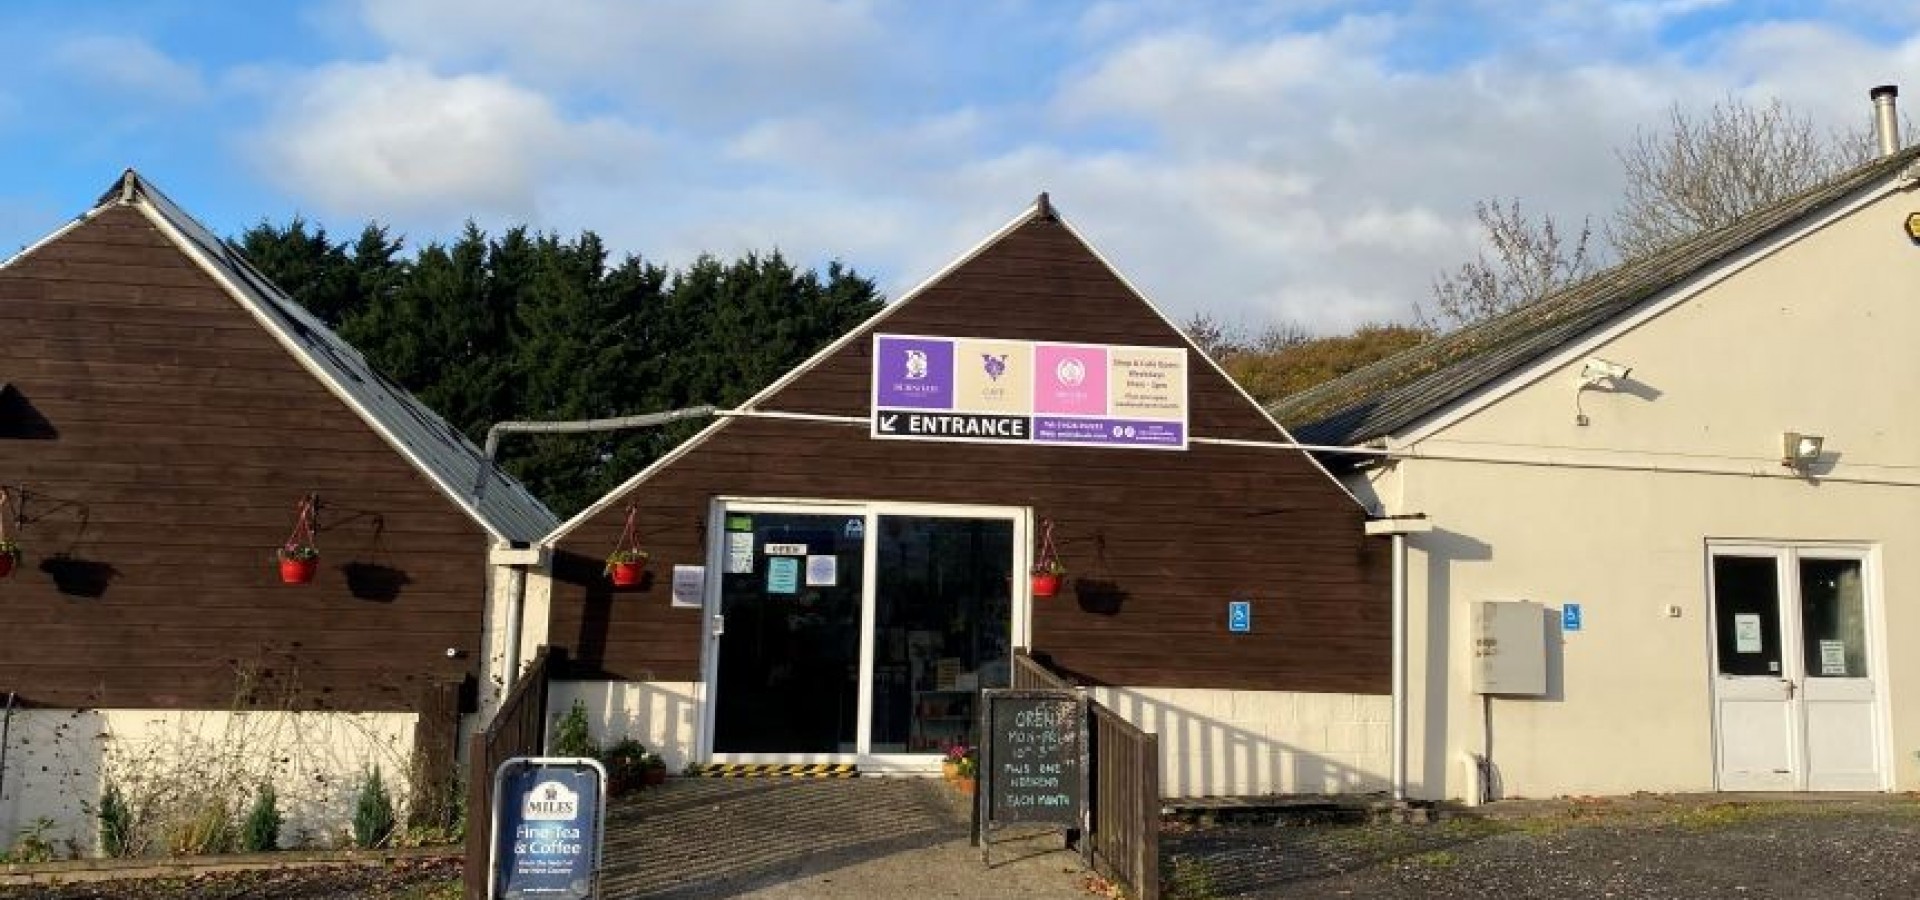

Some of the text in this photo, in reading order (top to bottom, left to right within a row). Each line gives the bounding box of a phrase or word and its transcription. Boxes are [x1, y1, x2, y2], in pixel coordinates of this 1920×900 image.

[908, 414, 1024, 436] ENTRANCE
[529, 801, 573, 813] MILES
[516, 824, 580, 839] Fine Tea
[514, 840, 581, 854] & Coffee
